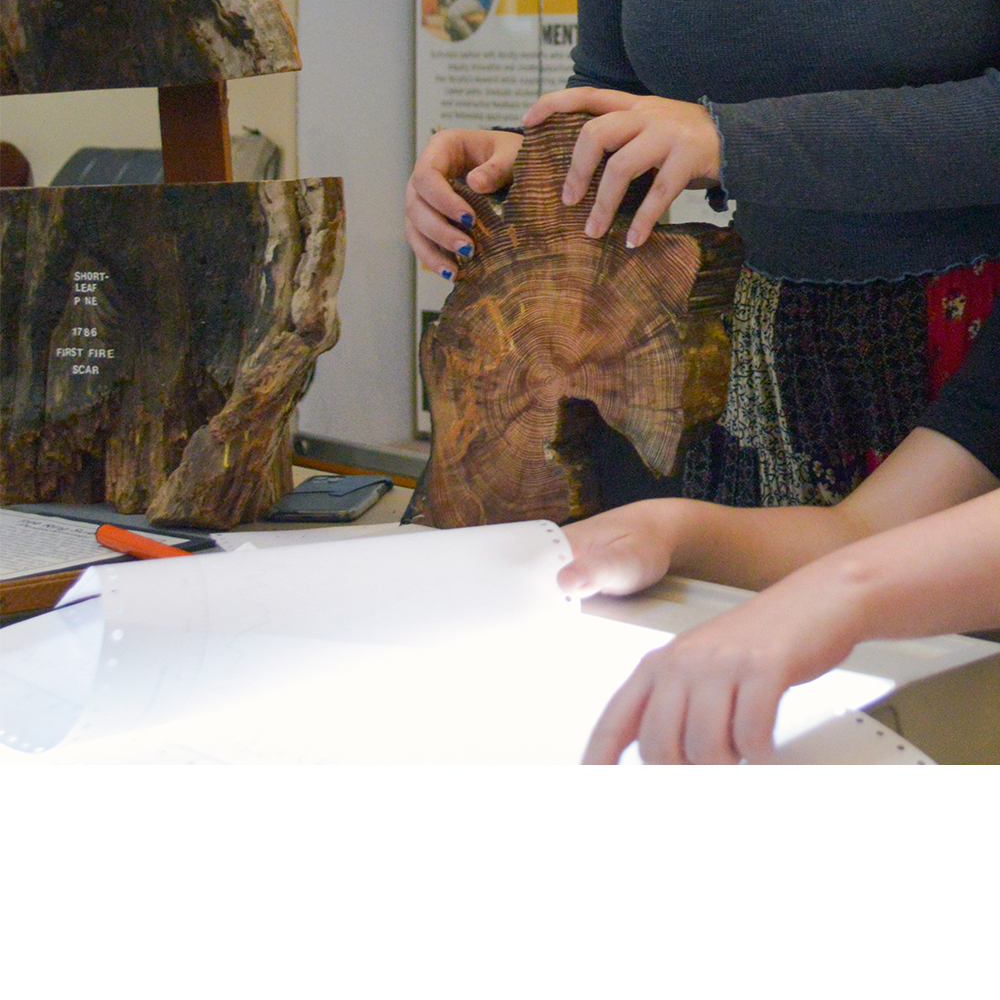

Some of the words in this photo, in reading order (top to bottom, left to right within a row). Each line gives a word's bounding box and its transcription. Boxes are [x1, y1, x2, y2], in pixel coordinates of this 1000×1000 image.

[73, 271, 109, 281] SHORT-
[75, 283, 98, 293] LEAF
[71, 327, 98, 337] 1786
[56, 348, 83, 357] FIRST
[88, 349, 115, 358] FIRE
[72, 365, 99, 375] SCAR
